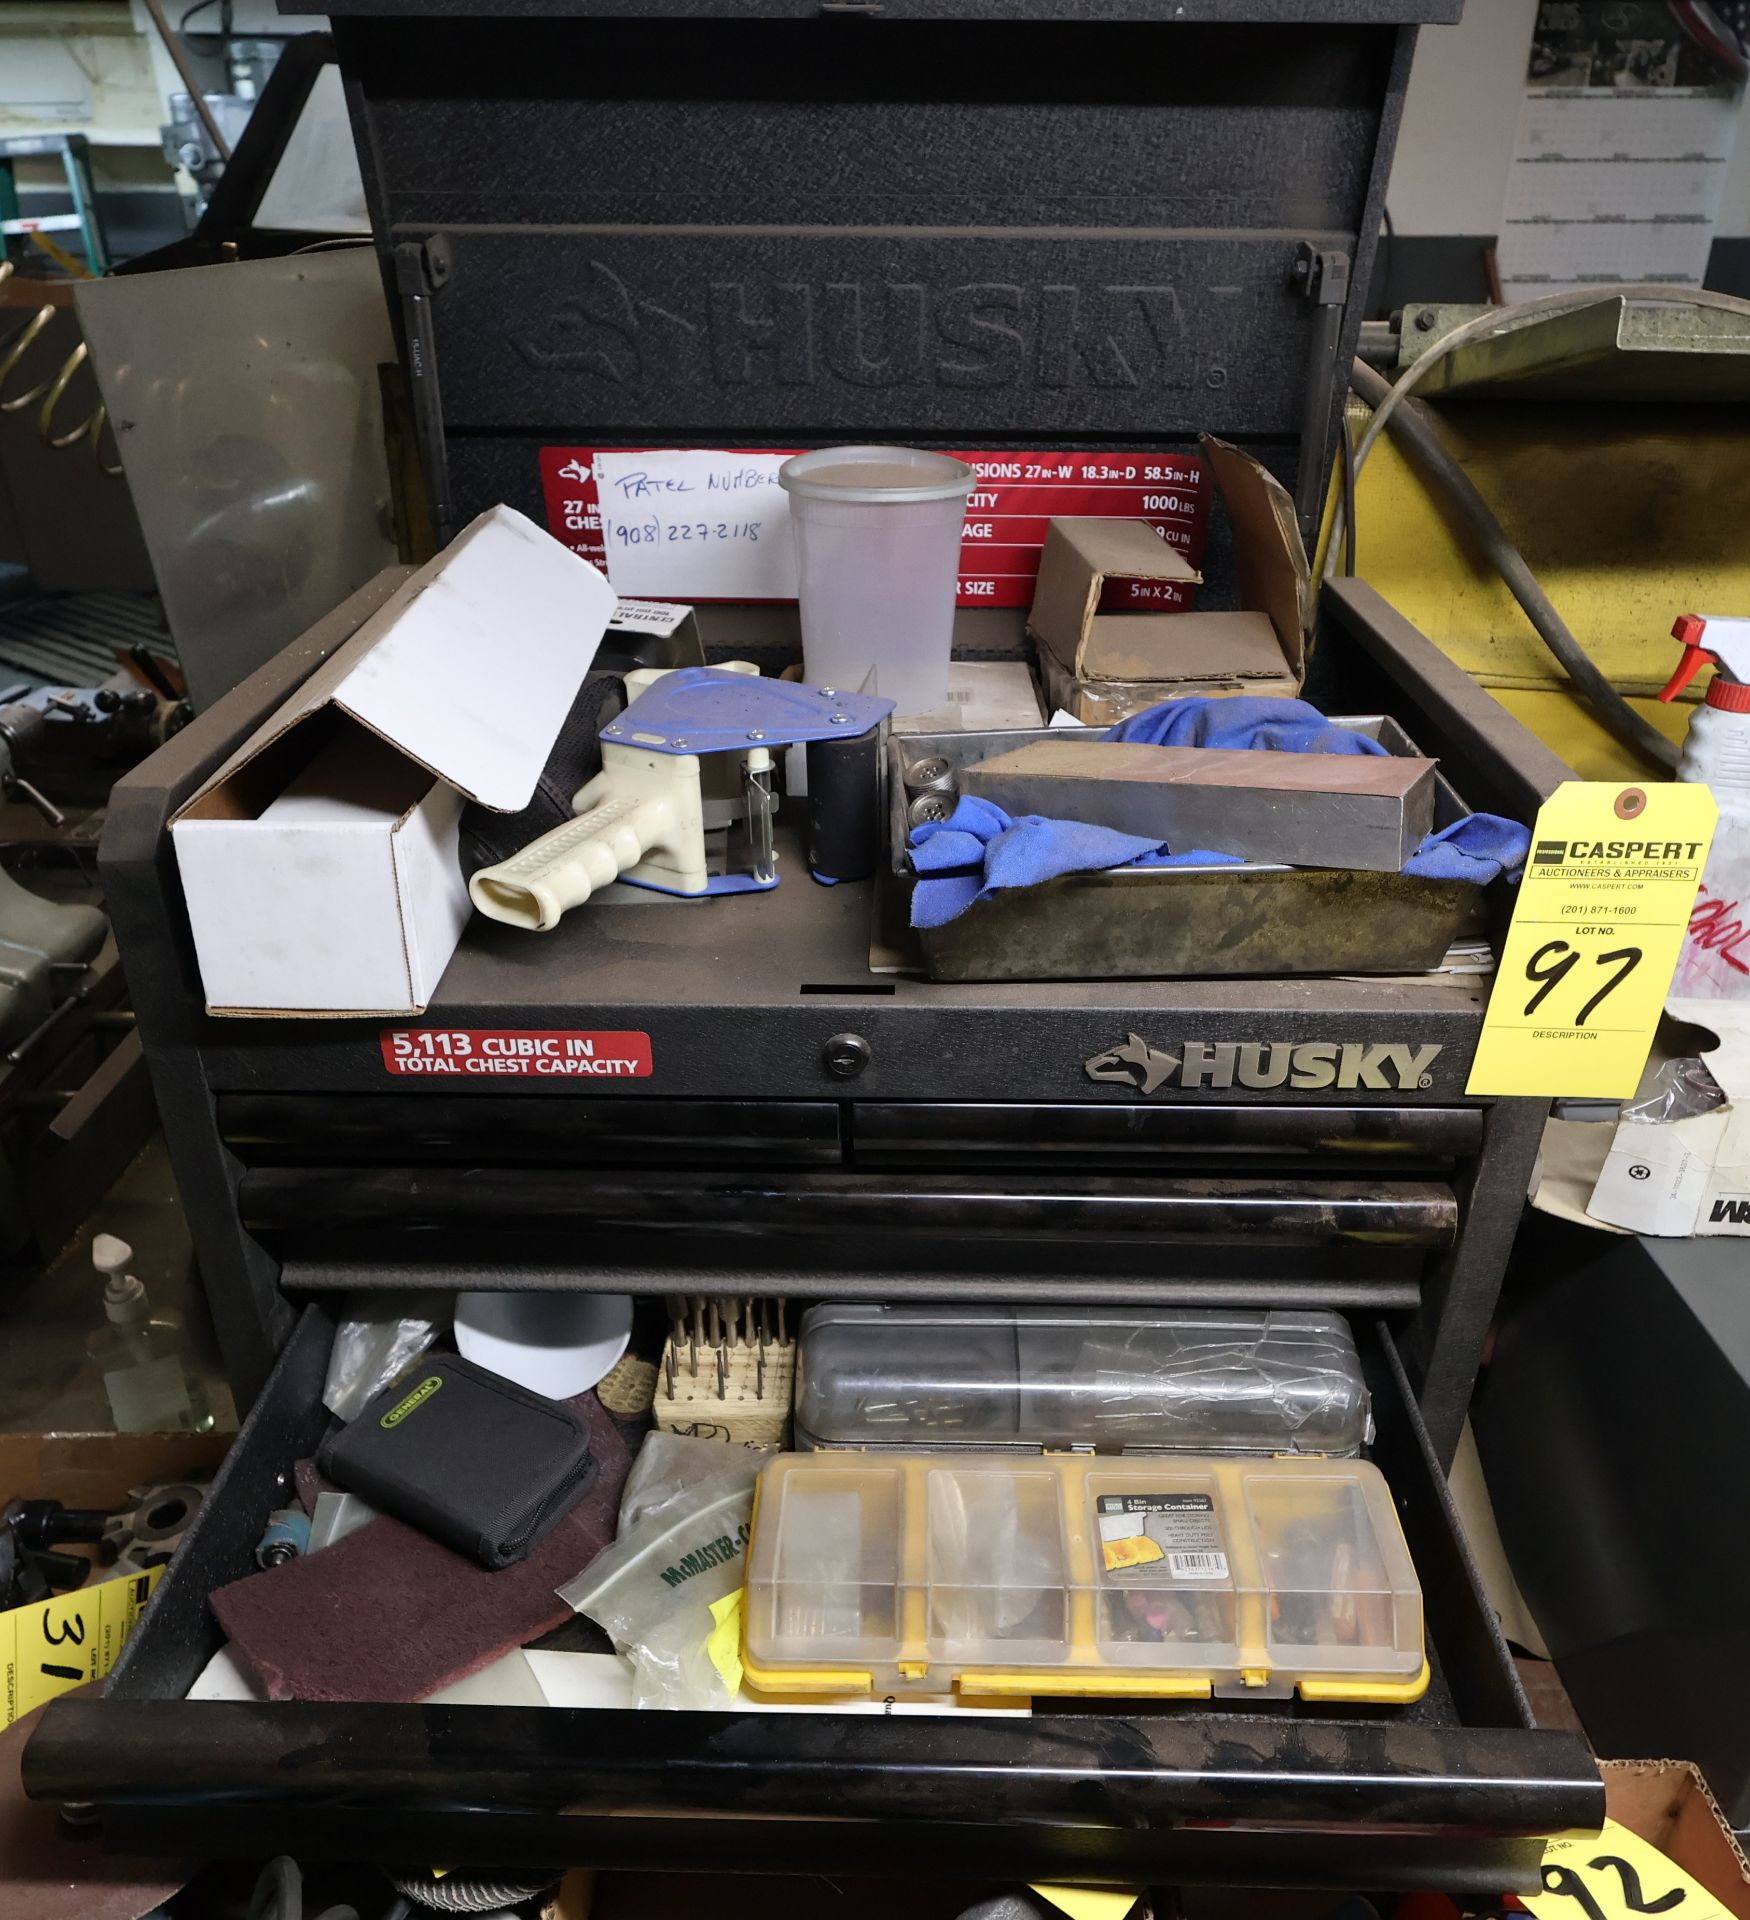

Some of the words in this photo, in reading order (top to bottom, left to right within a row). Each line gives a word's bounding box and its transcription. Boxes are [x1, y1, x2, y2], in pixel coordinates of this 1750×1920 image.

[709, 282, 1243, 389] HUSKY
[970, 463, 1021, 478] SIONS
[615, 472, 695, 499] PATEL
[707, 468, 779, 490] NUMBER
[563, 500, 583, 514] 27
[1141, 495, 1178, 511] 1000
[1178, 501, 1195, 514] LBS
[565, 515, 603, 530] CHE
[1165, 531, 1179, 542] CU
[1181, 533, 1191, 544] IN
[965, 581, 995, 595] SIZE
[1569, 841, 1703, 860] CASPERT
[1538, 867, 1612, 878] AUCTIONEERS
[1613, 868, 1621, 878] &
[1622, 868, 1690, 878] APPRAISERS
[1561, 905, 1588, 916] (201)
[1590, 906, 1637, 915] 871-1600
[1575, 927, 1596, 935] LOT
[1597, 927, 1615, 935] NO.
[1524, 940, 1642, 1026] 97
[1532, 1031, 1598, 1040] DESCRIPTION
[392, 1033, 472, 1058] 5,113
[481, 1038, 560, 1056] CUBIC
[566, 1039, 594, 1057] IN
[395, 1057, 461, 1072] TOTAL
[465, 1057, 530, 1073] CHEST
[531, 1058, 639, 1074] CAPACITY
[1181, 1041, 1443, 1089] HUSKY
[388, 1382, 434, 1422] GENERAL
[1128, 1503, 1163, 1512] Storage
[1164, 1503, 1209, 1511] Container
[660, 1523, 751, 1587] McMASTER-C
[41, 1607, 85, 1681] 31
[7, 1663, 16, 1726] DESCRIPTIO
[1541, 1855, 1688, 1920] 92
